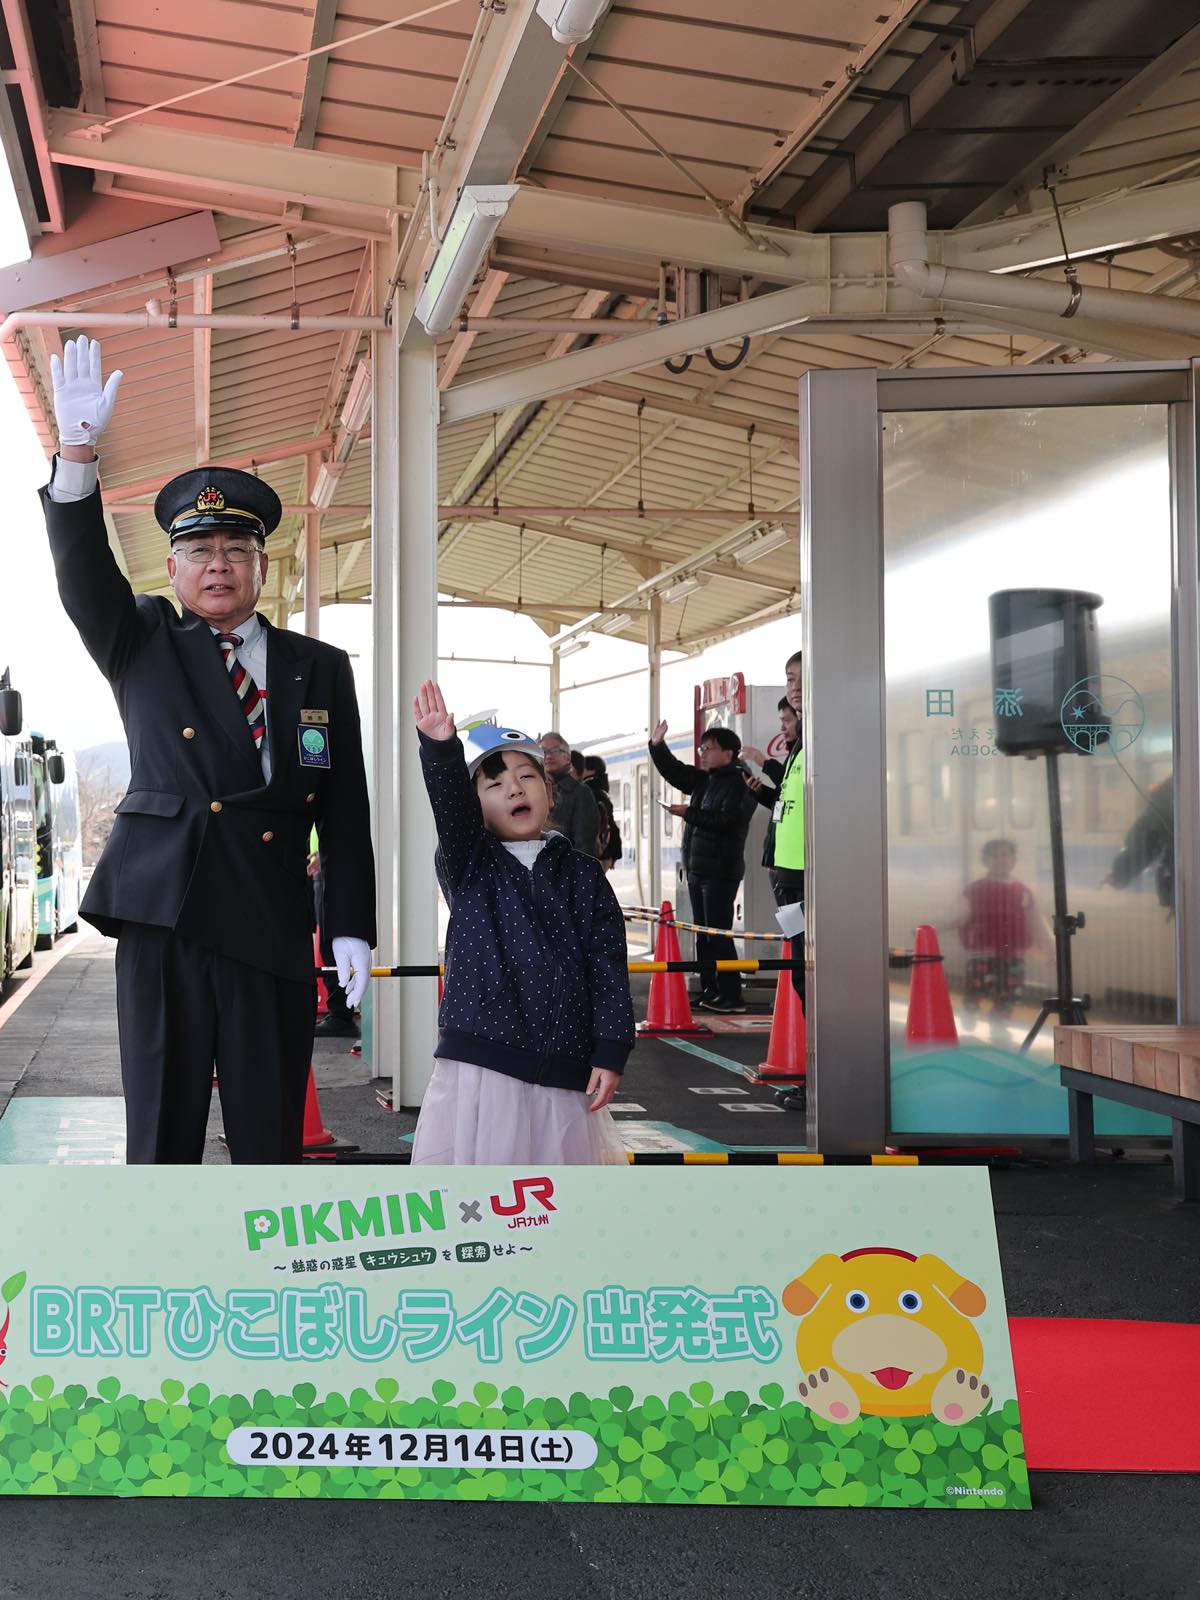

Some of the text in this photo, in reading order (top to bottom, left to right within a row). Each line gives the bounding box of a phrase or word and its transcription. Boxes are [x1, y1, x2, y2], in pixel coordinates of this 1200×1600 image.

[203, 492, 217, 502] JR
[490, 1177, 557, 1216] JR
[508, 1214, 549, 1229] JR九州
[30, 1283, 782, 1365] BRTひこぼしライン 出発式
[250, 1431, 574, 1465] 2024年12月14日(土)
